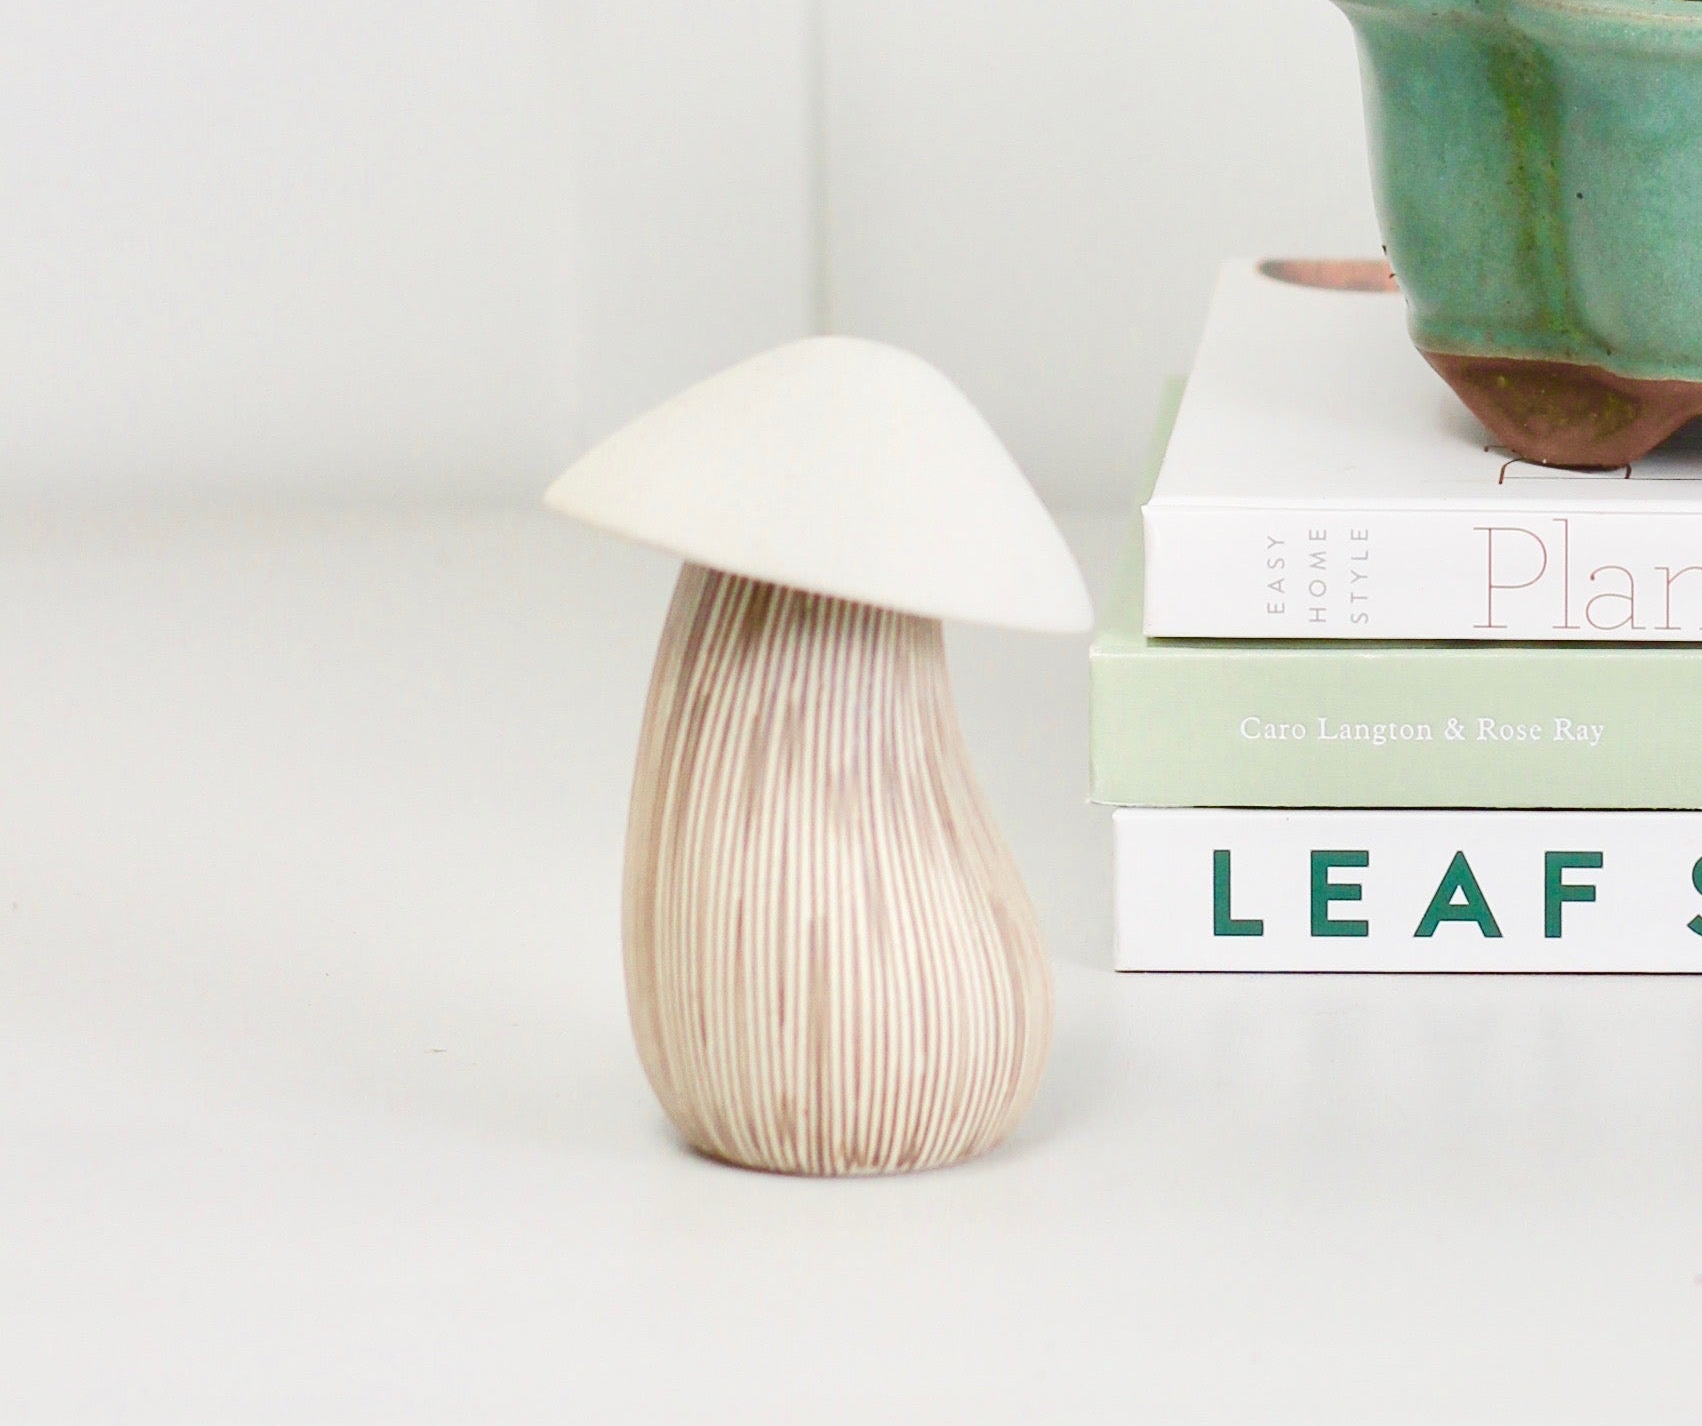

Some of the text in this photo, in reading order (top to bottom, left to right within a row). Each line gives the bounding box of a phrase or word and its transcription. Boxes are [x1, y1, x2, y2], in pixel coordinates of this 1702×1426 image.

[1266, 535, 1286, 614] EASY
[1308, 529, 1327, 623] HOME
[1349, 529, 1369, 624] STYLE
[1239, 716, 1605, 747] Caro Langton & Rose Ray
[1212, 849, 1604, 938] LEAF
